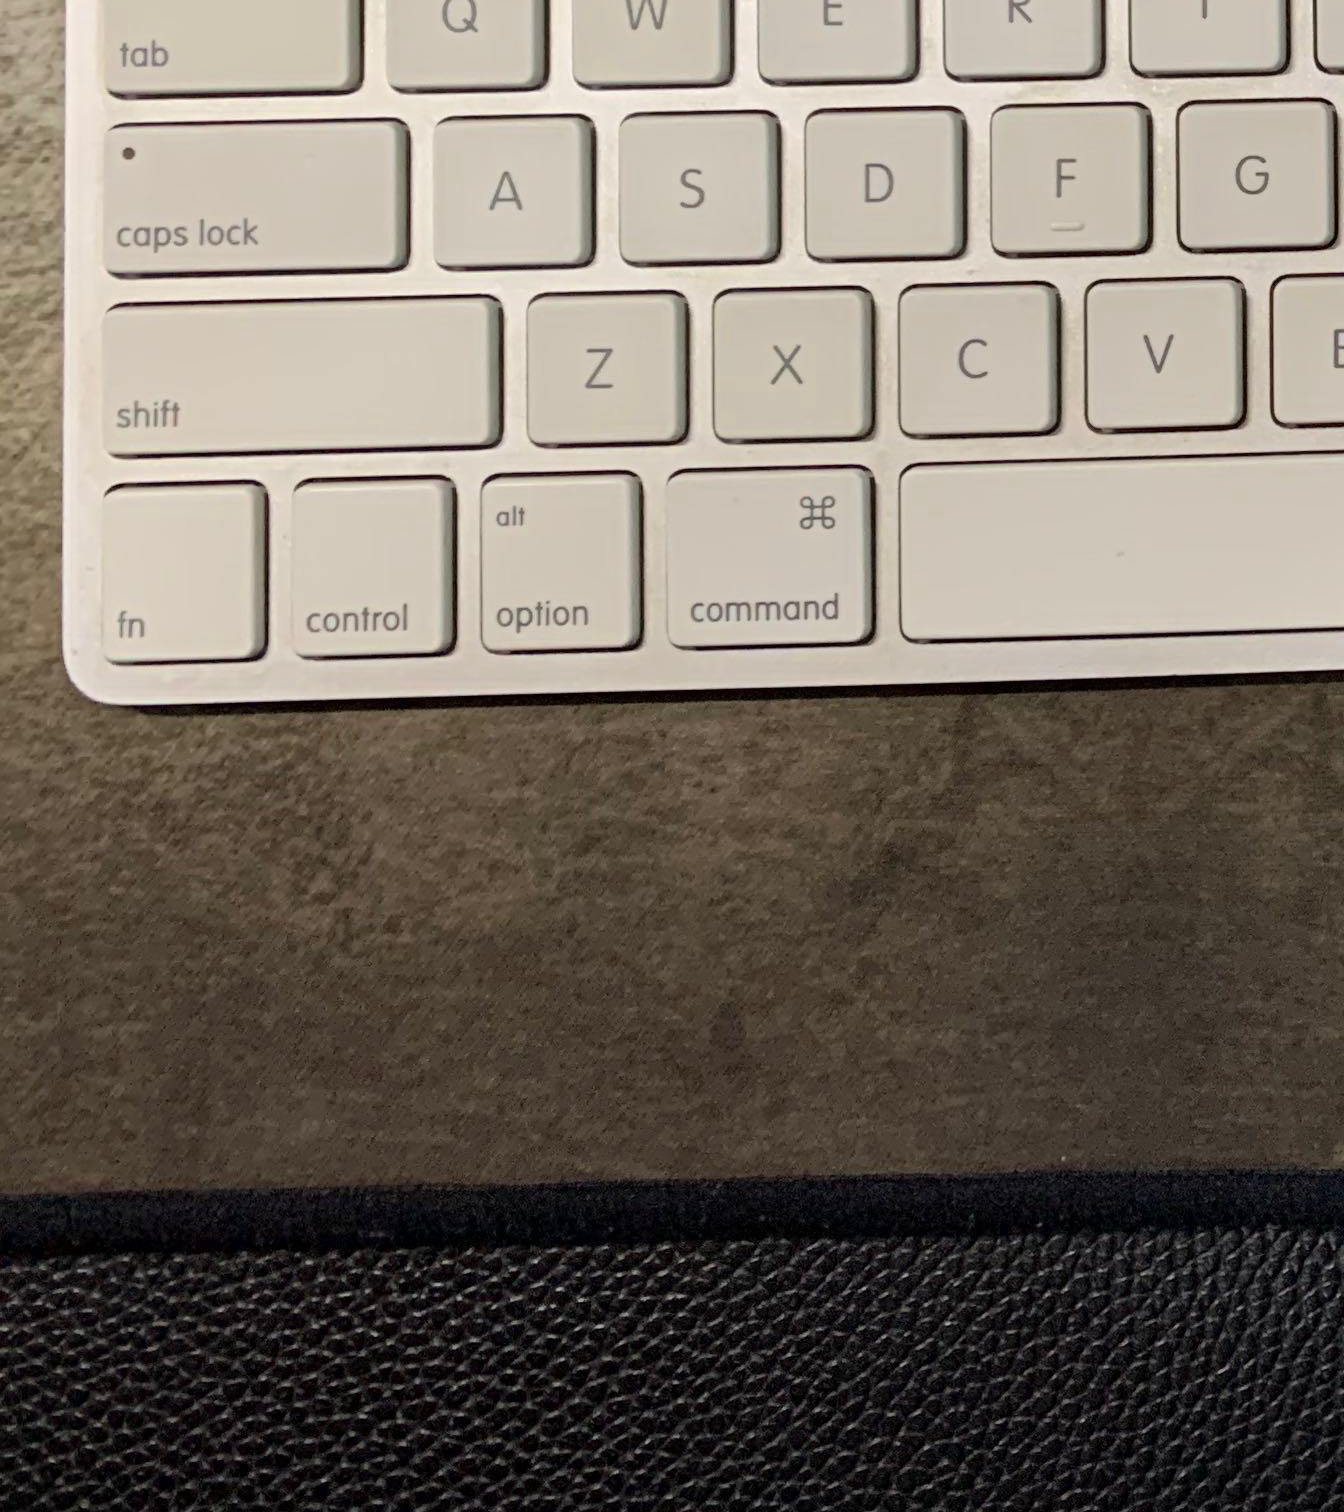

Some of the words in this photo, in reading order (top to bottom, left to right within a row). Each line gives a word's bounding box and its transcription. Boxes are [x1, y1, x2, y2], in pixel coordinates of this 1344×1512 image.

[119, 39, 169, 68] tab
[489, 170, 523, 211] A
[679, 168, 705, 209] S
[864, 162, 894, 203] D
[1054, 157, 1078, 200] F
[1234, 155, 1270, 196] G
[116, 226, 189, 254] caps
[199, 217, 259, 247] lock
[584, 348, 614, 389] Z
[770, 344, 804, 385] X
[958, 338, 989, 379] C
[1143, 333, 1175, 374] V
[116, 399, 181, 429] shift
[494, 504, 527, 528] alt
[117, 610, 145, 639] fn
[306, 603, 408, 633] control
[496, 600, 589, 634] option
[690, 592, 839, 623] command
